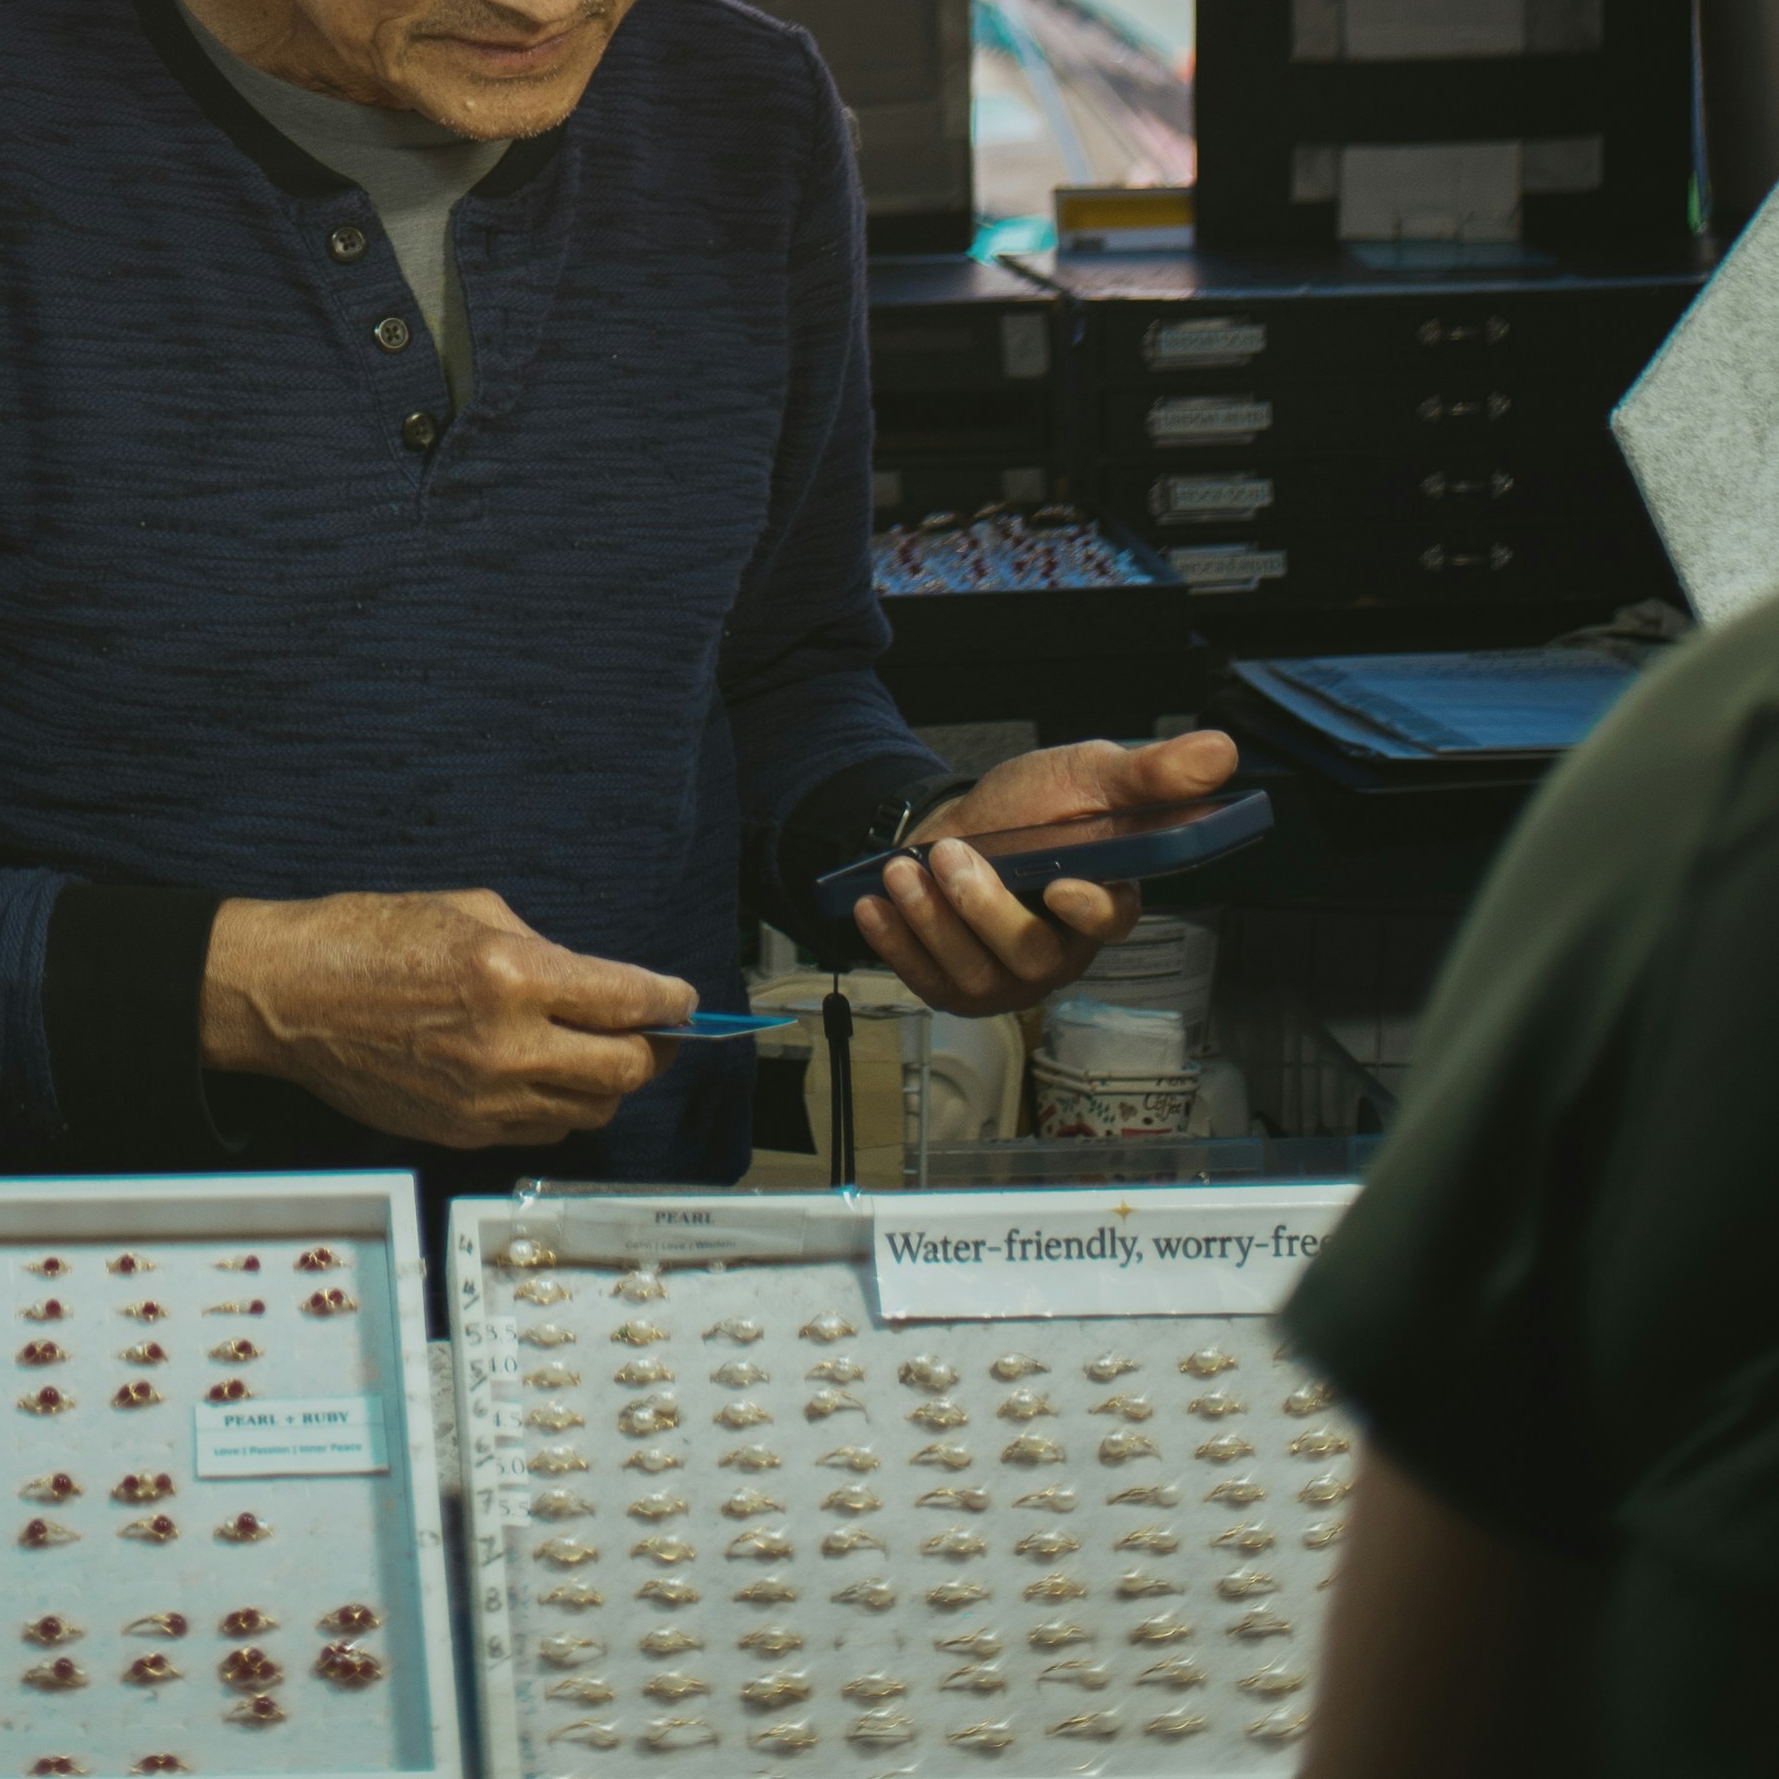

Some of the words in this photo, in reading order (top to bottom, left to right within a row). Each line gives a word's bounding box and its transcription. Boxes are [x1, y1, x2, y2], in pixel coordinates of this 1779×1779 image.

[654, 1211, 715, 1226] PEARL
[625, 1240, 652, 1250] Calm
[661, 1240, 686, 1250] Love
[885, 1226, 1144, 1270] Water-friendly,
[464, 1321, 483, 1347] 5
[472, 1398, 489, 1419] 6
[224, 1413, 279, 1428] PEARL
[301, 1411, 350, 1425] RUBY
[213, 1447, 240, 1457] Love
[249, 1444, 290, 1456] Passion
[330, 1441, 363, 1452] Peace
[484, 1587, 503, 1614] 8
